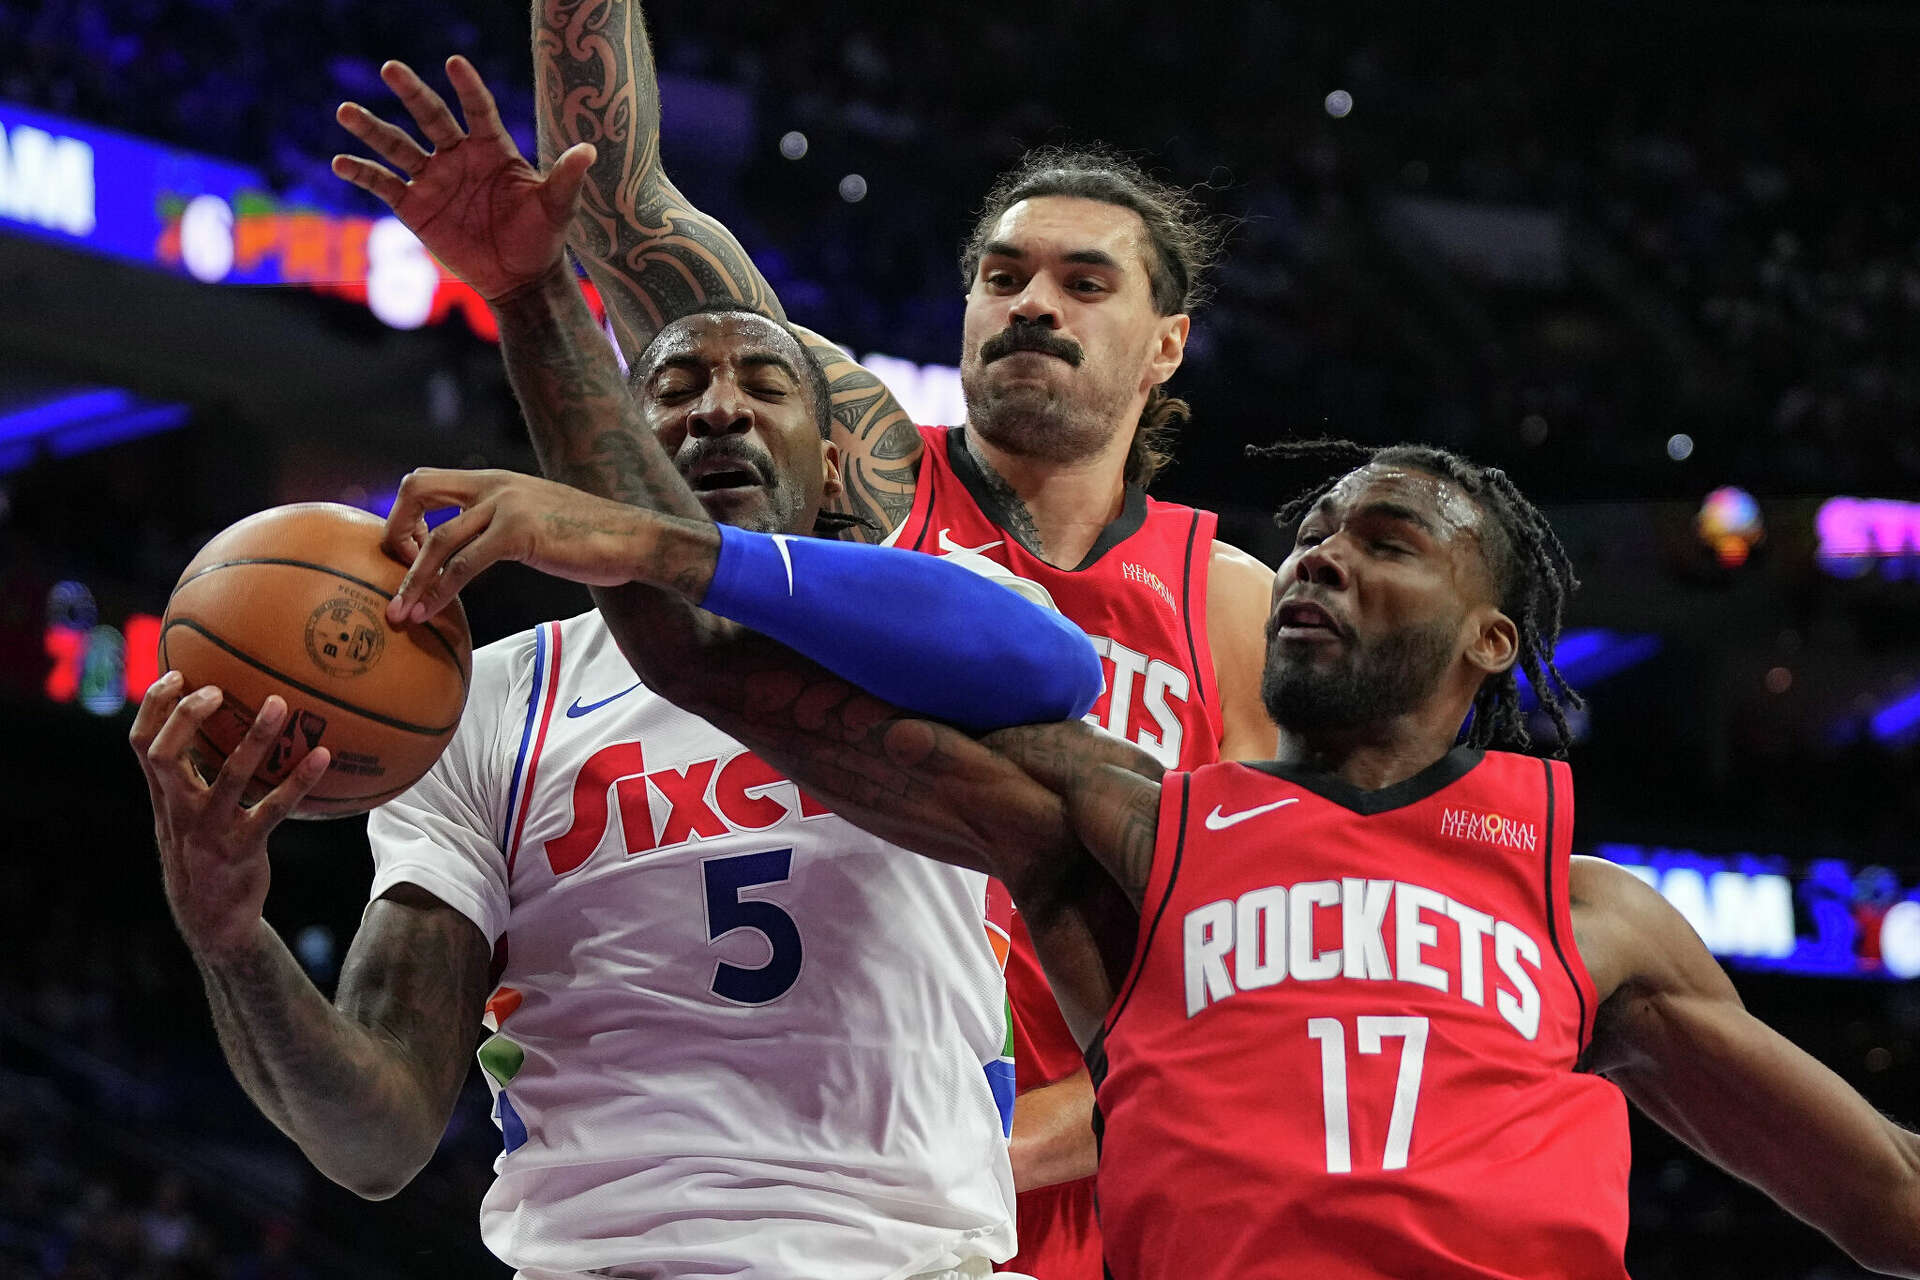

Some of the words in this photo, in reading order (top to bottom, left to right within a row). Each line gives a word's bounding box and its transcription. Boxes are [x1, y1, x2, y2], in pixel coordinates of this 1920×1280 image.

[1440, 820, 1538, 852] HERMANN
[1442, 807, 1536, 840] MEMORIAL
[701, 848, 804, 1007] 5
[1183, 876, 1542, 1043] ROCKETS
[1307, 1015, 1430, 1175] 17
